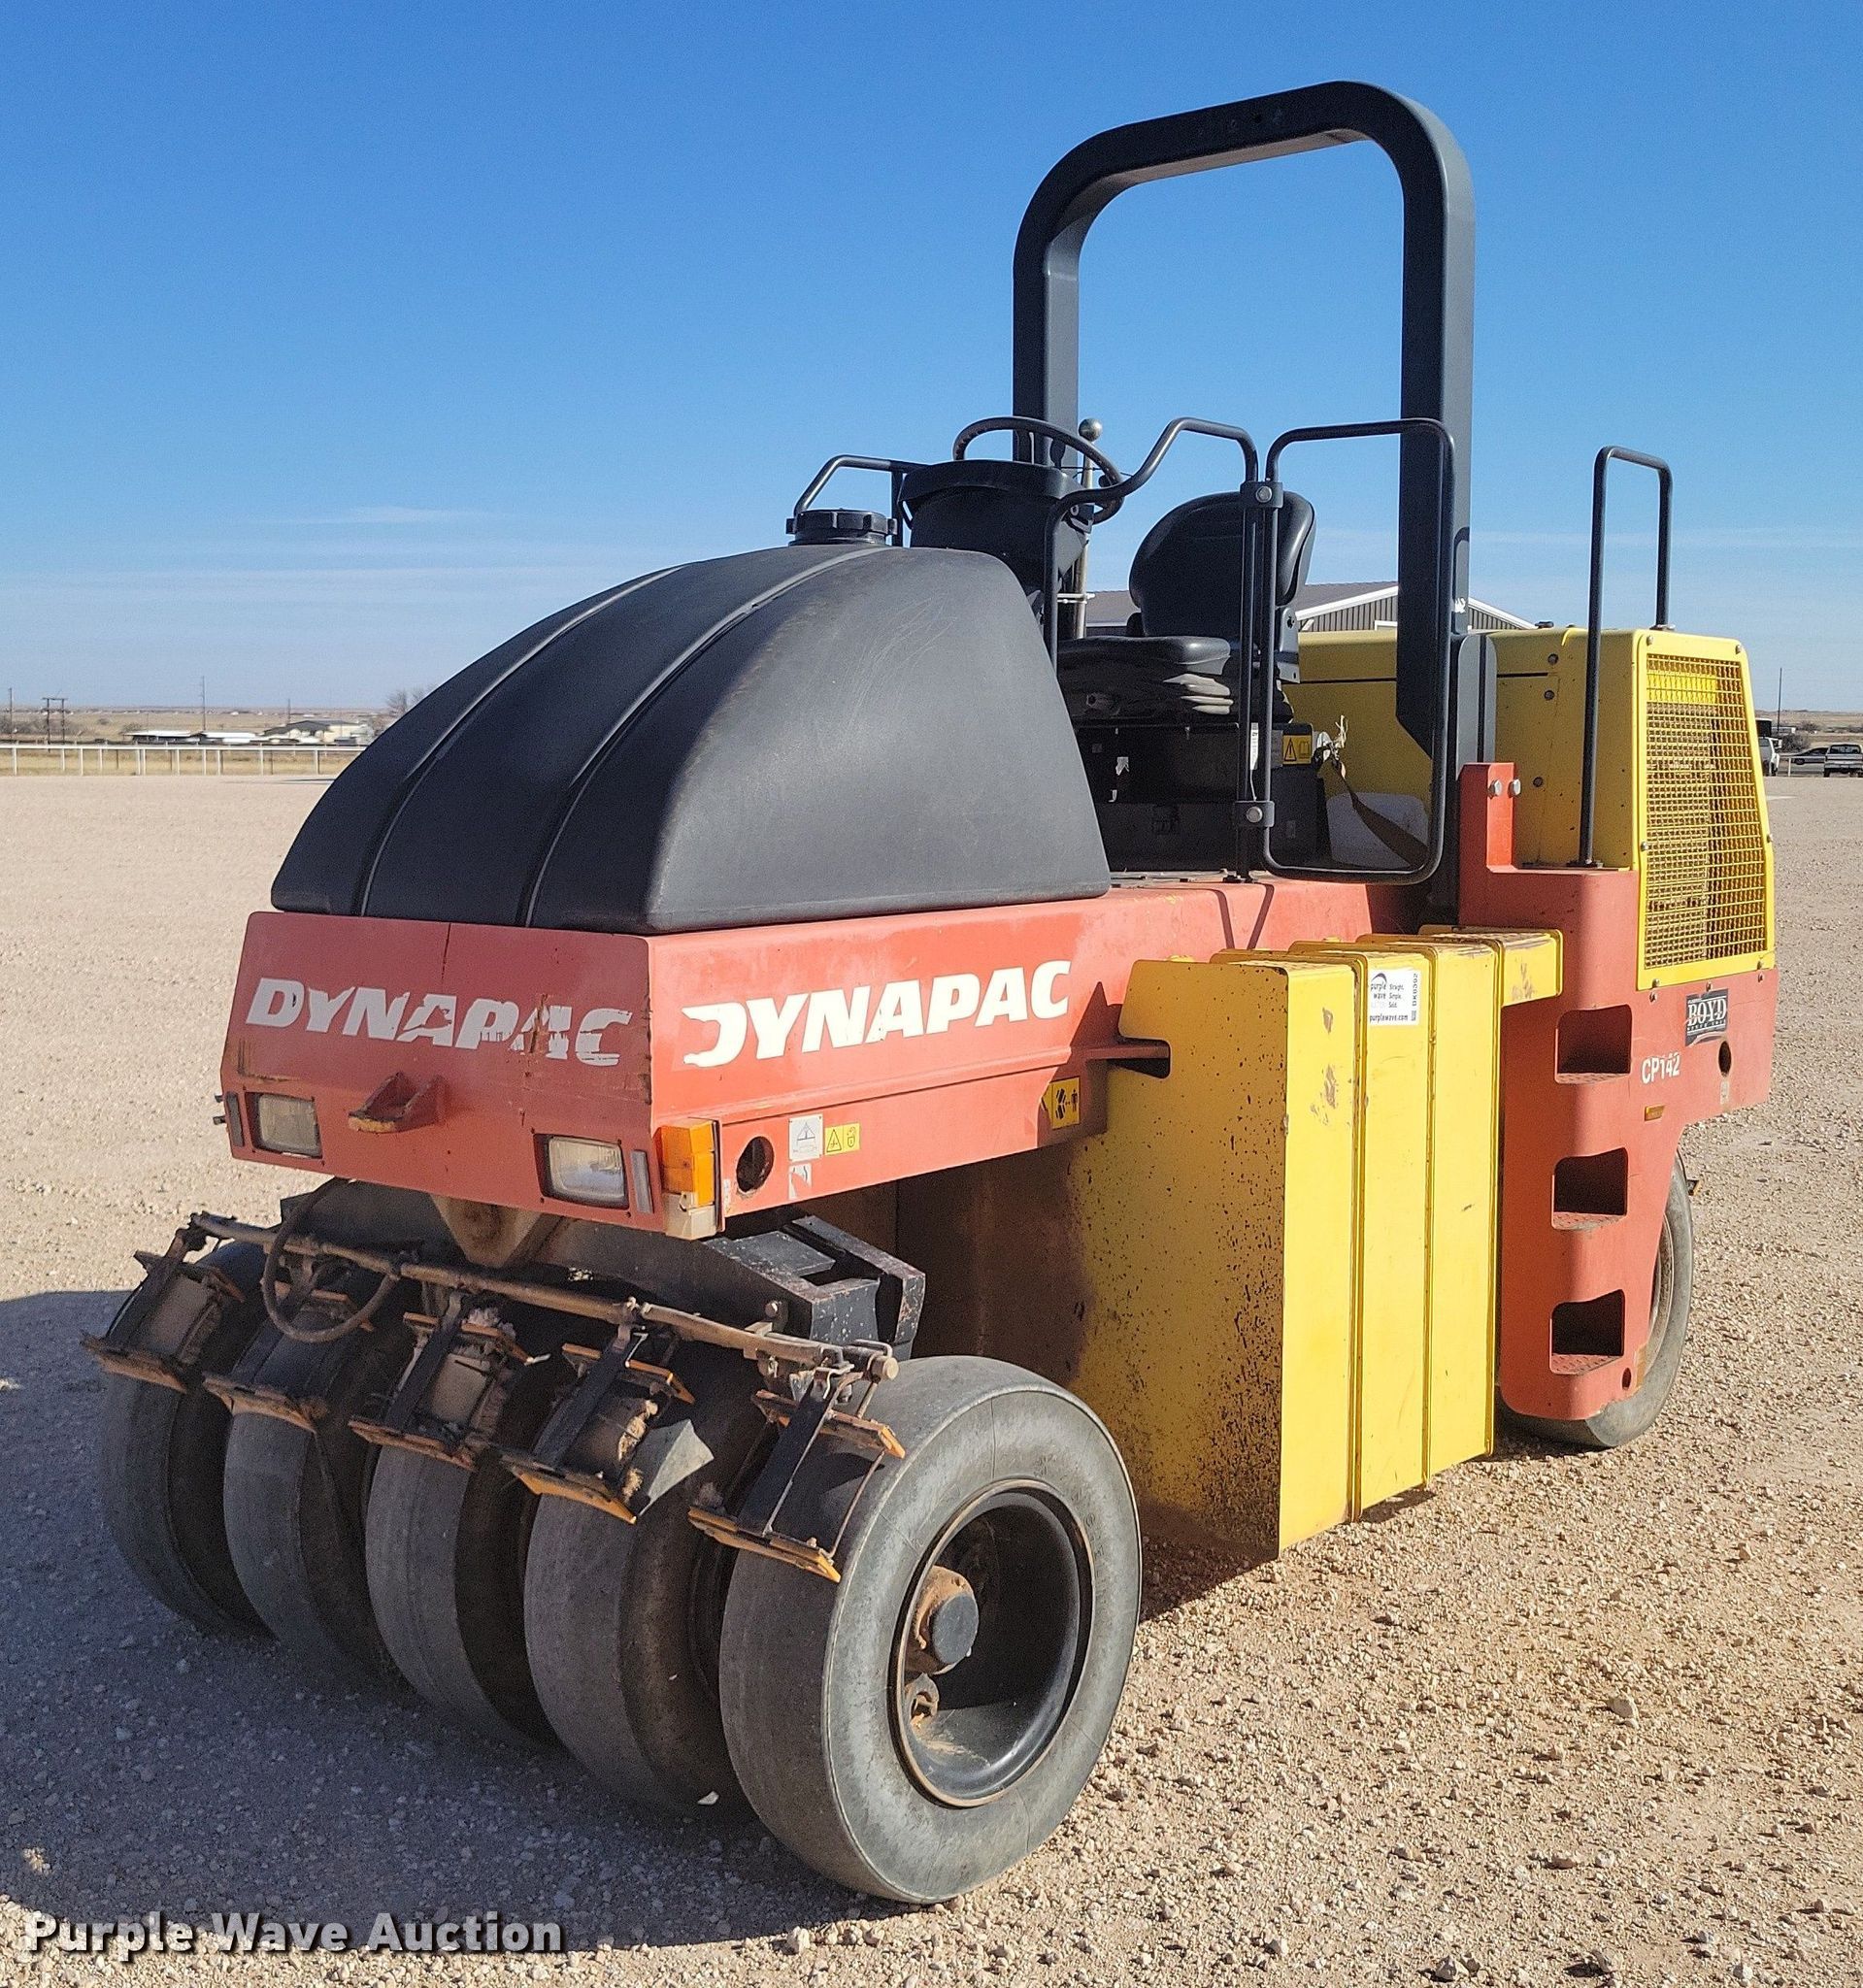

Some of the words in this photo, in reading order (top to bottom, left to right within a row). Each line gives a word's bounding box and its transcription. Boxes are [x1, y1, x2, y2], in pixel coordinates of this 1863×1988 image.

[1371, 981, 1386, 991] purple
[246, 977, 633, 1066] DYNAPAC
[682, 960, 1072, 1068] DYNAPAC
[1370, 1013, 1409, 1023] purplewave.com
[1687, 998, 1727, 1027] BOYD
[1641, 1052, 1680, 1084] CP142
